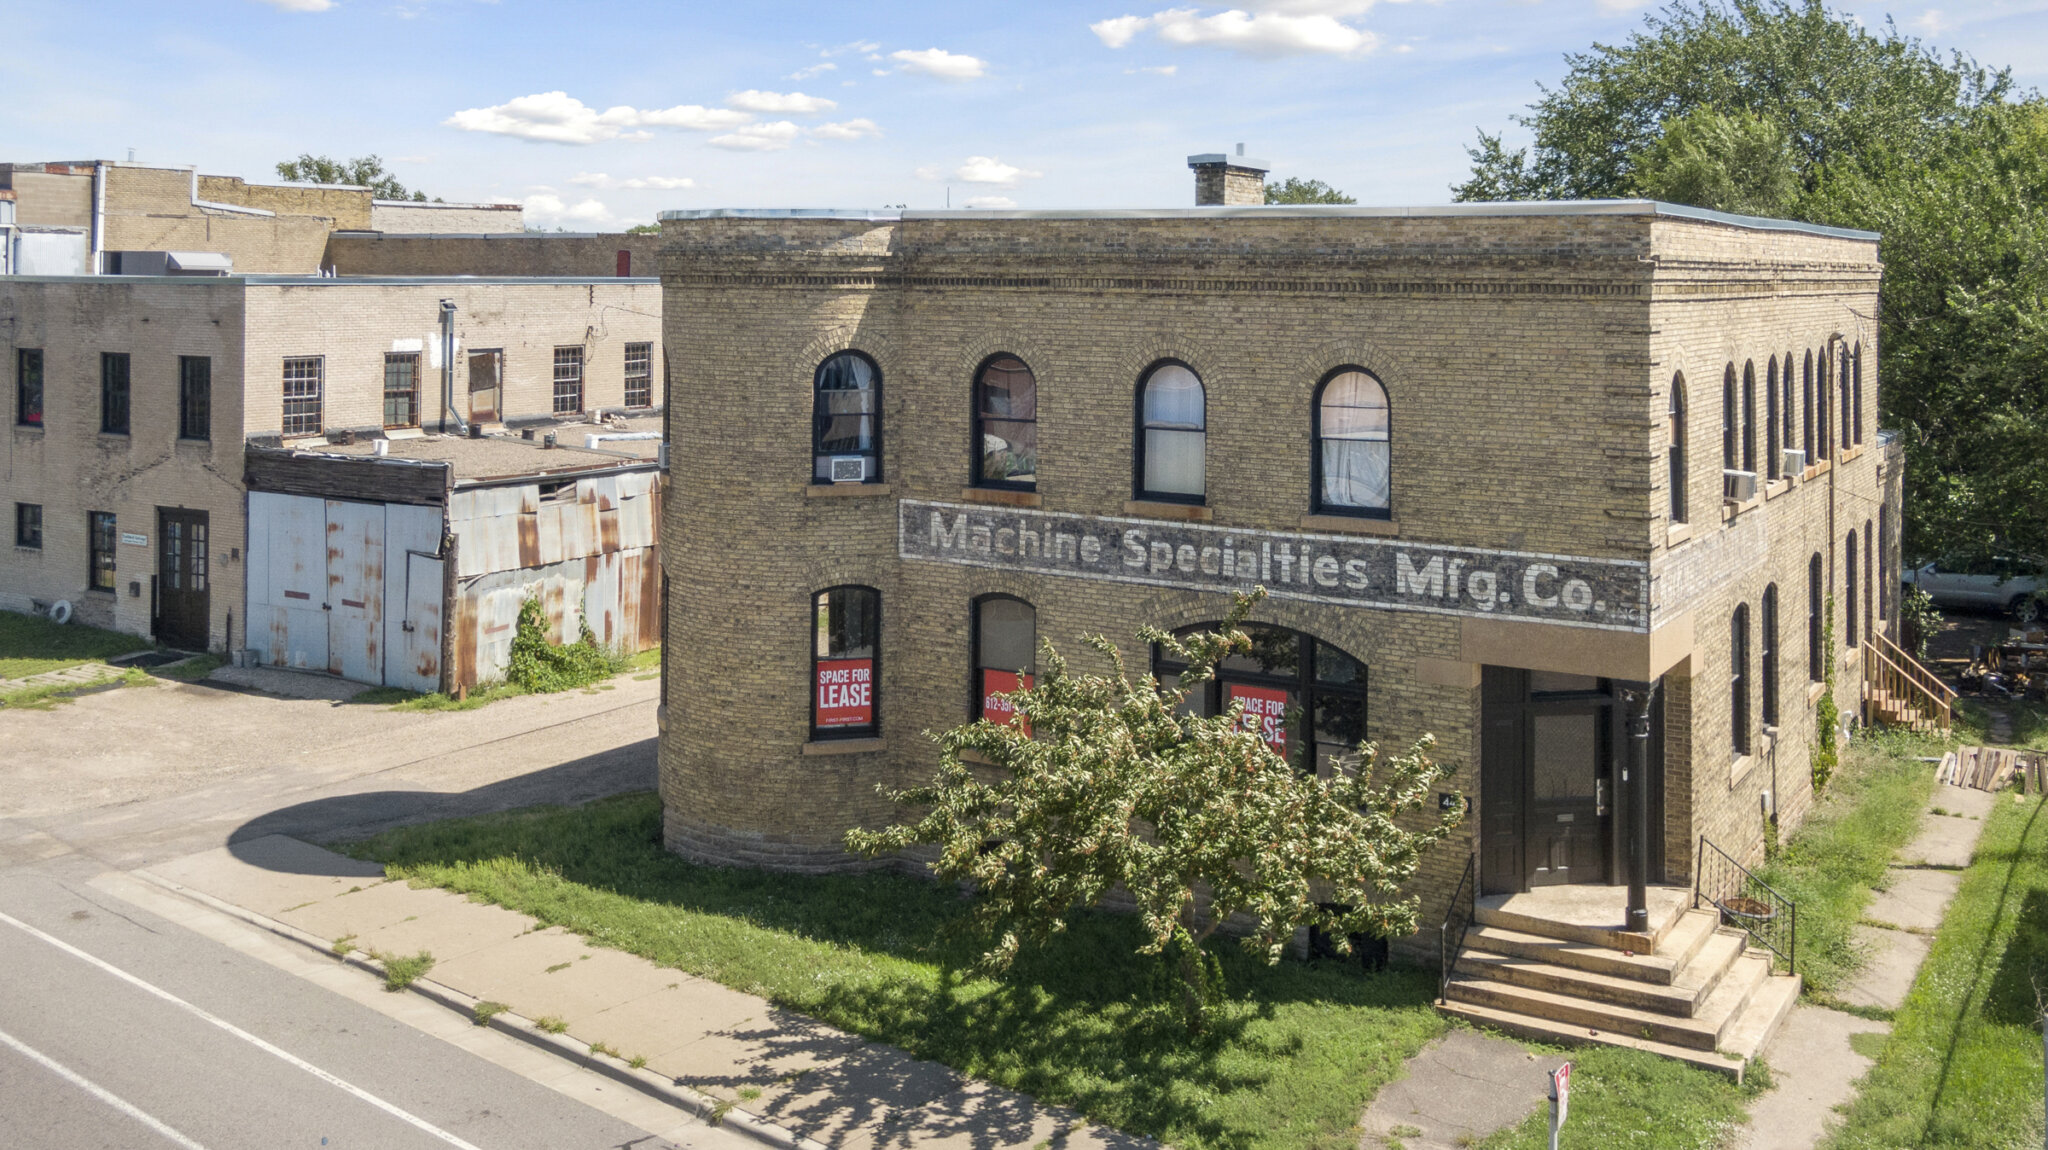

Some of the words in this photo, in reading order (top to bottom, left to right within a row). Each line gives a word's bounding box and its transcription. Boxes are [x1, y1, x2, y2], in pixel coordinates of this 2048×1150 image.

[930, 510, 1101, 563] Machine
[1122, 529, 1370, 590] Specialties
[1522, 562, 1606, 612] Co.
[820, 669, 849, 684] SPACE
[852, 668, 870, 682] FOR
[820, 683, 870, 709] LEASE
[1266, 700, 1284, 716] FOR
